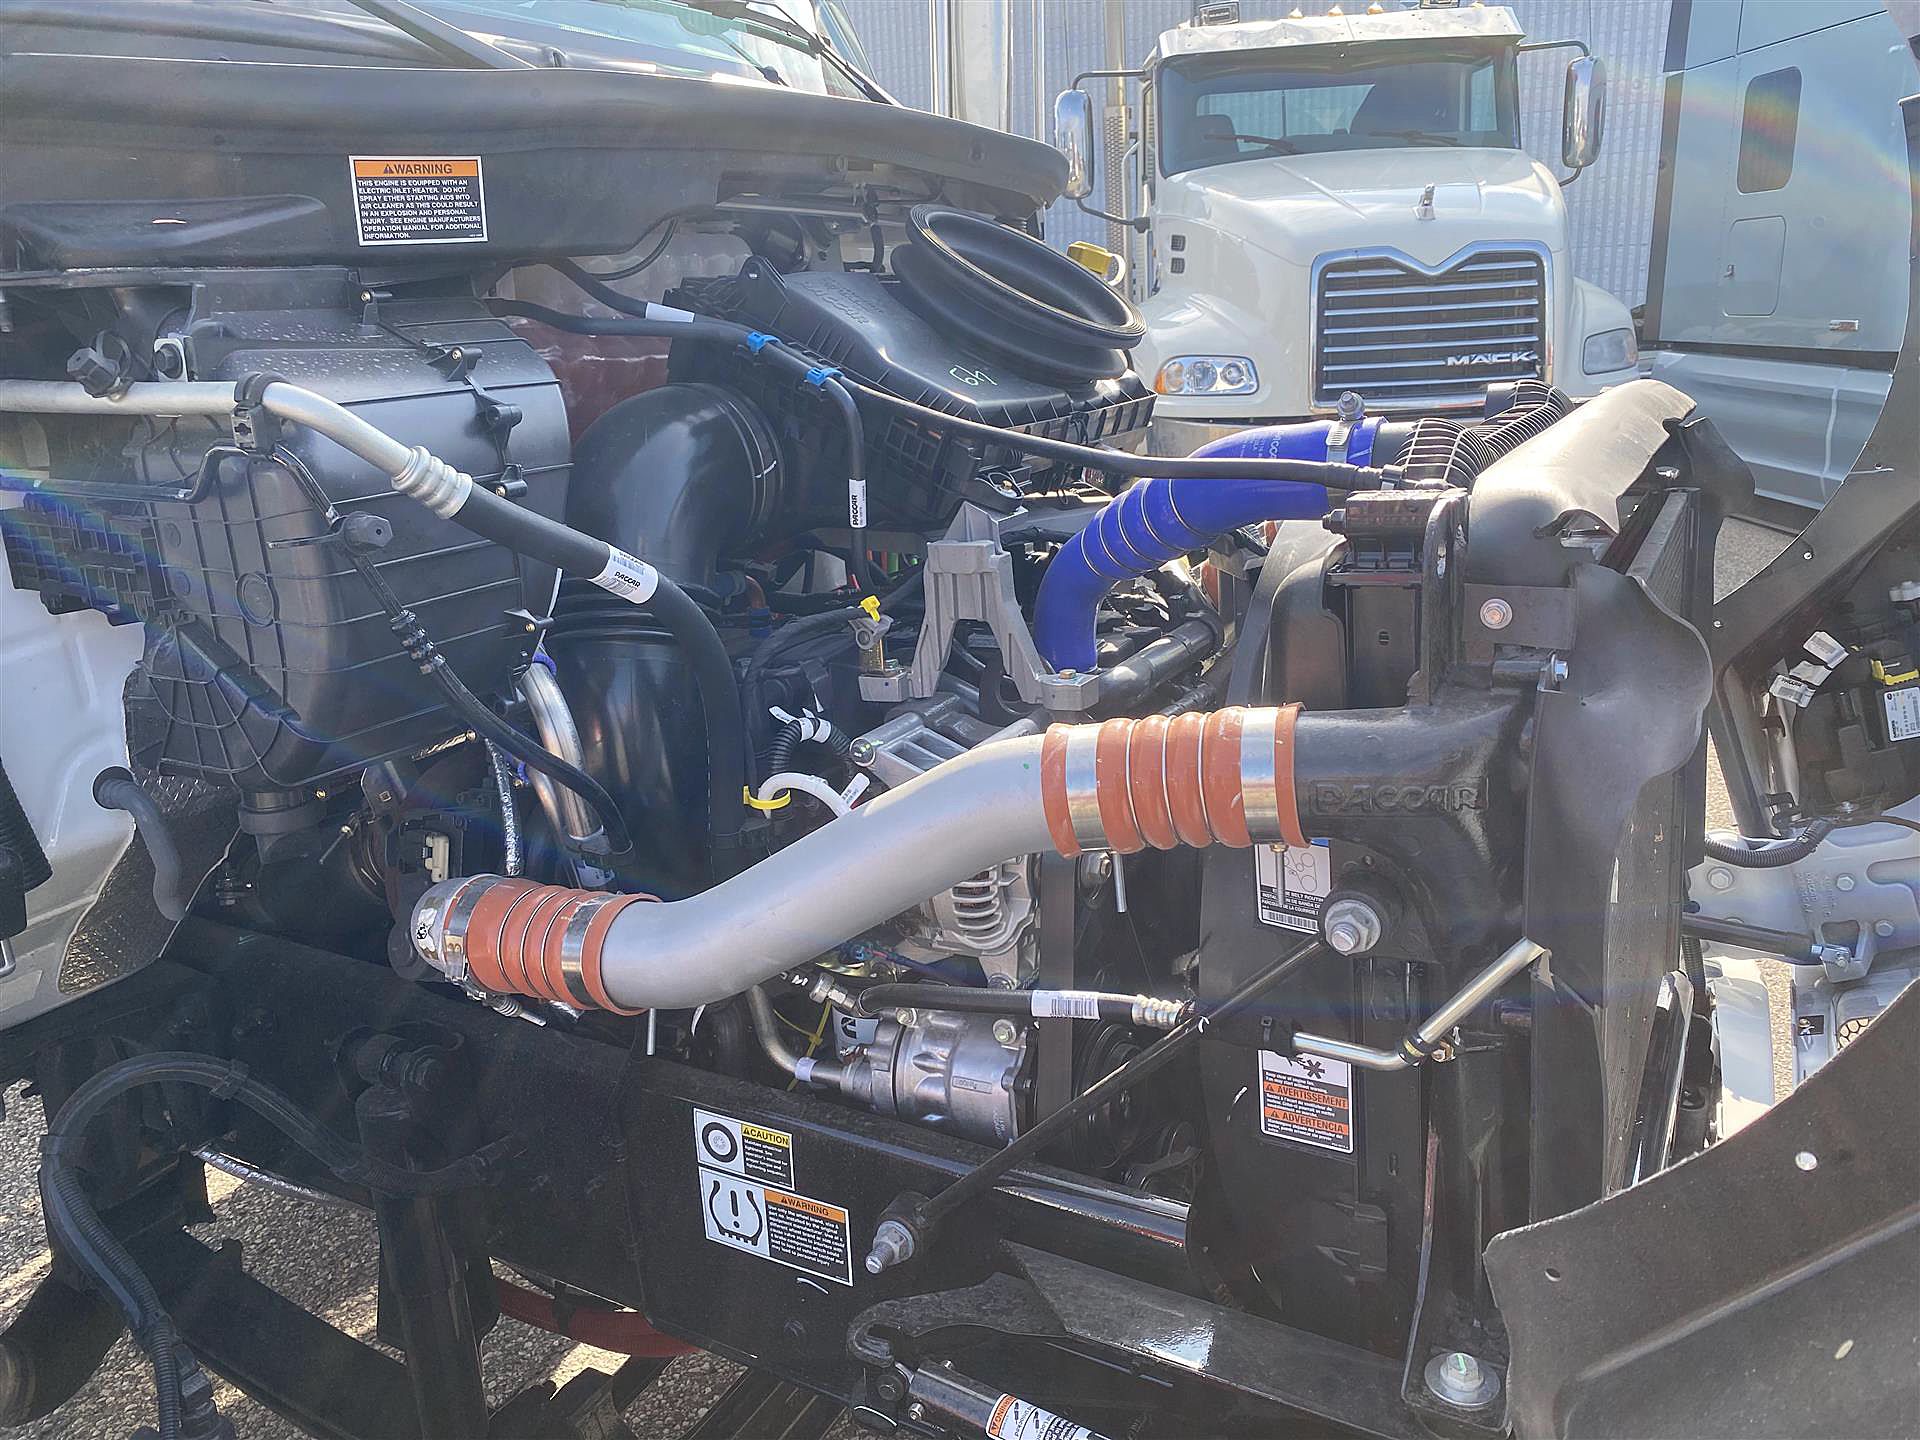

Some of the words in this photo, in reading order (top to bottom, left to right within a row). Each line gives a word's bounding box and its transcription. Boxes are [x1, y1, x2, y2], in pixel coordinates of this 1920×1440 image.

[394, 164, 452, 174] WARNING
[1447, 351, 1538, 366] MACK
[851, 494, 859, 526] PACCAR
[614, 571, 641, 588] PACCAR
[1314, 784, 1480, 813] PACCAR
[1278, 1085, 1347, 1107] AVERTISSEMENT
[1283, 1112, 1343, 1132] ADVERTENCIA
[750, 1128, 788, 1146] CAUTION
[788, 1199, 829, 1216] WARNING
